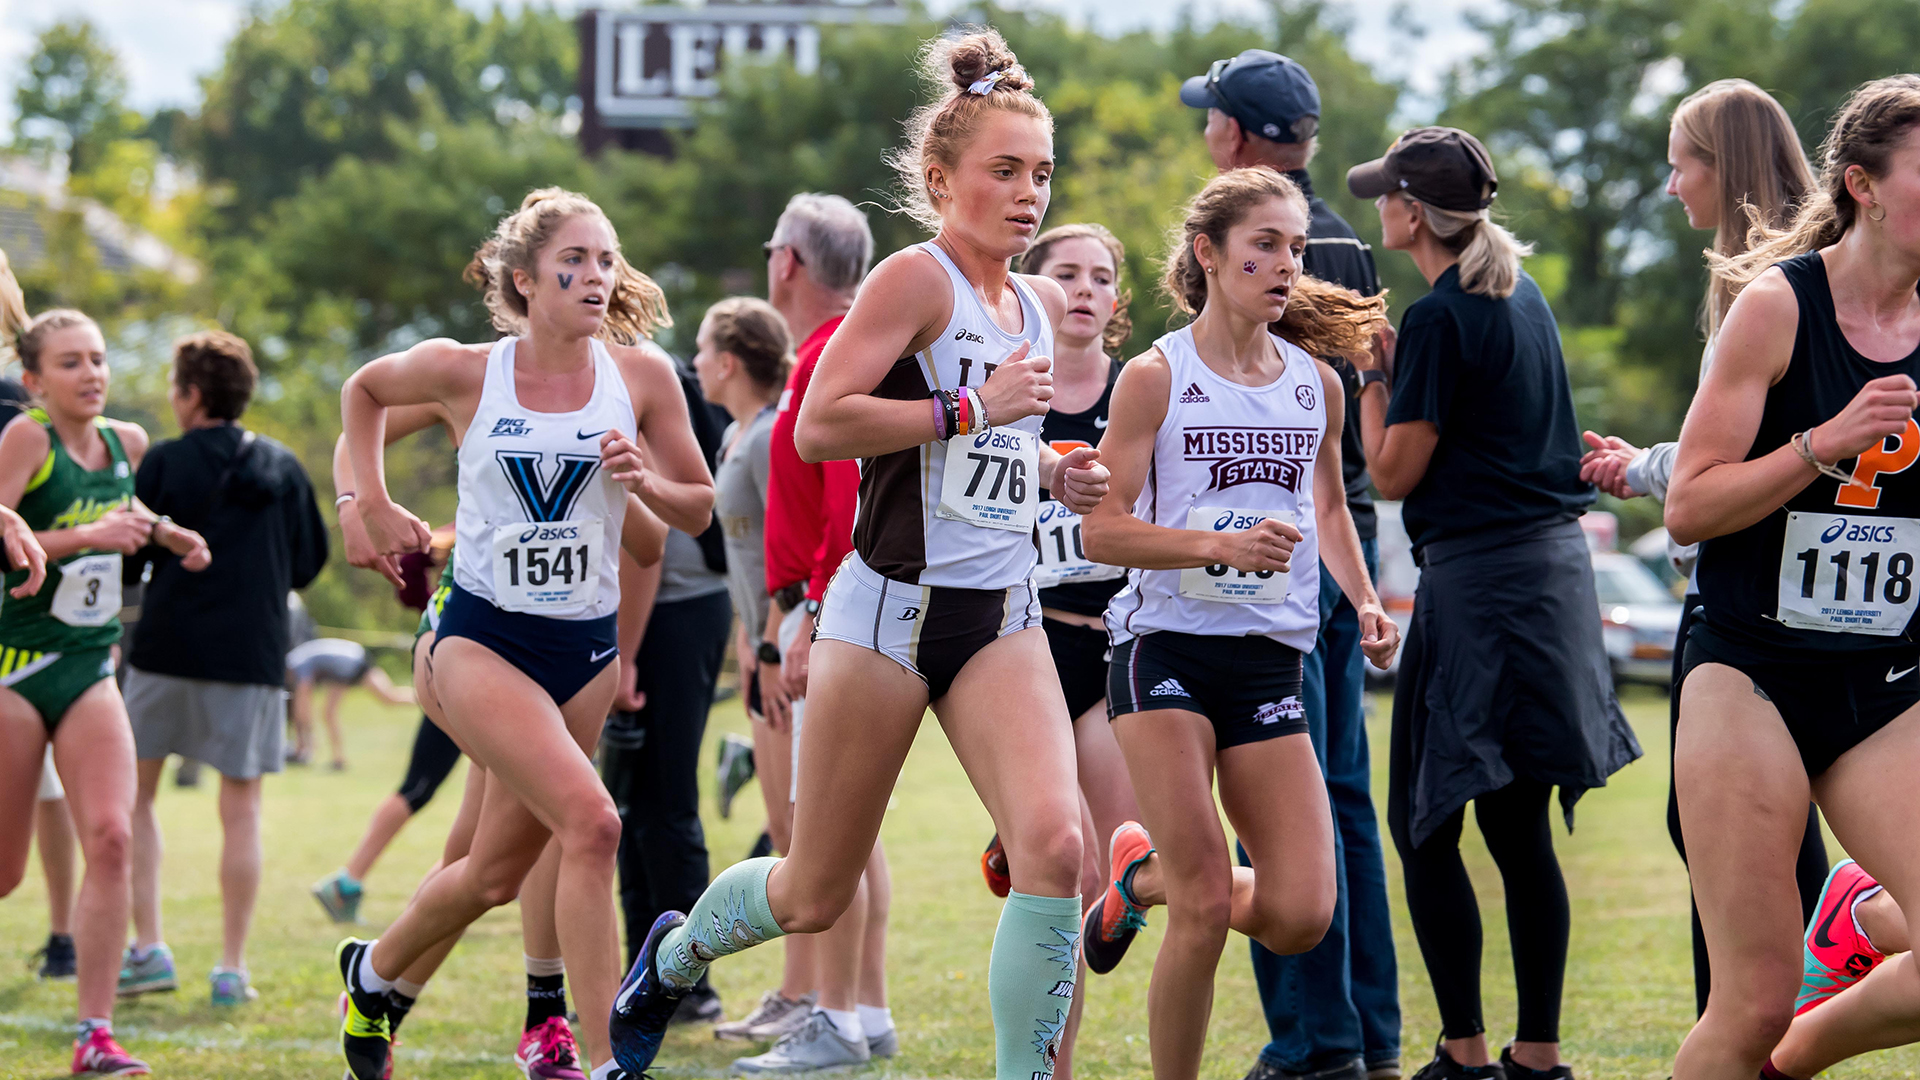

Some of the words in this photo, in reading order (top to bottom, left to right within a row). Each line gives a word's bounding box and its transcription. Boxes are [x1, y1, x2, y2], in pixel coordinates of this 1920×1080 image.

[557, 272, 574, 290] V
[965, 332, 985, 345] asics
[1179, 394, 1210, 404] adidas
[491, 425, 534, 436] EAST
[497, 417, 527, 427] BIG
[991, 432, 1021, 451] asics
[1835, 417, 1920, 509] P
[964, 452, 1026, 504] 776
[1226, 461, 1292, 485] STATE
[495, 450, 602, 523] V
[1234, 516, 1266, 529] asi
[539, 526, 578, 540] asics
[1846, 524, 1895, 543] asics
[503, 544, 588, 586] 1541
[1796, 548, 1914, 604] 1118
[85, 578, 100, 607] 3
[1821, 607, 1836, 615] 2017
[1150, 688, 1191, 698] adidas
